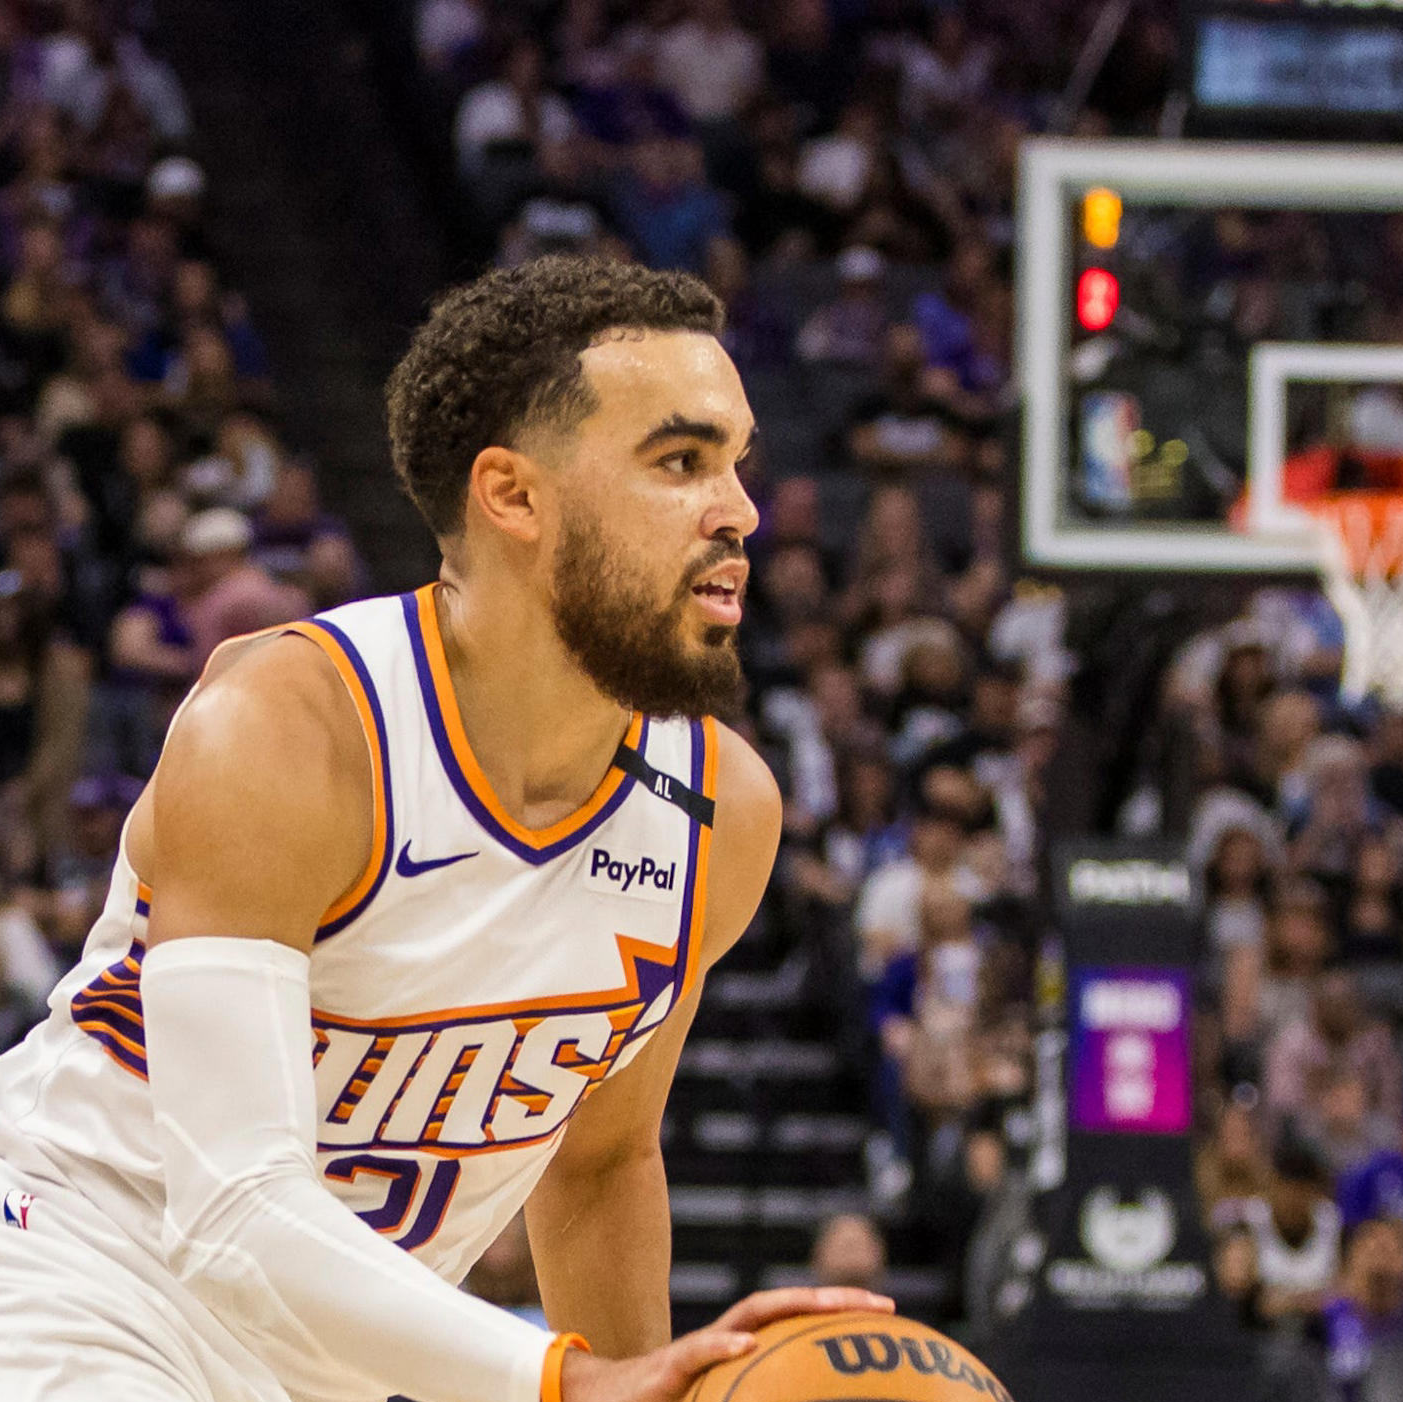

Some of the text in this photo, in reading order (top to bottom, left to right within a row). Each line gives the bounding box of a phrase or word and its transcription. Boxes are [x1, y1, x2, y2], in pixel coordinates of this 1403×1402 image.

[655, 775, 672, 799] AL
[591, 848, 676, 891] PayPal
[312, 1011, 612, 1144] UNS
